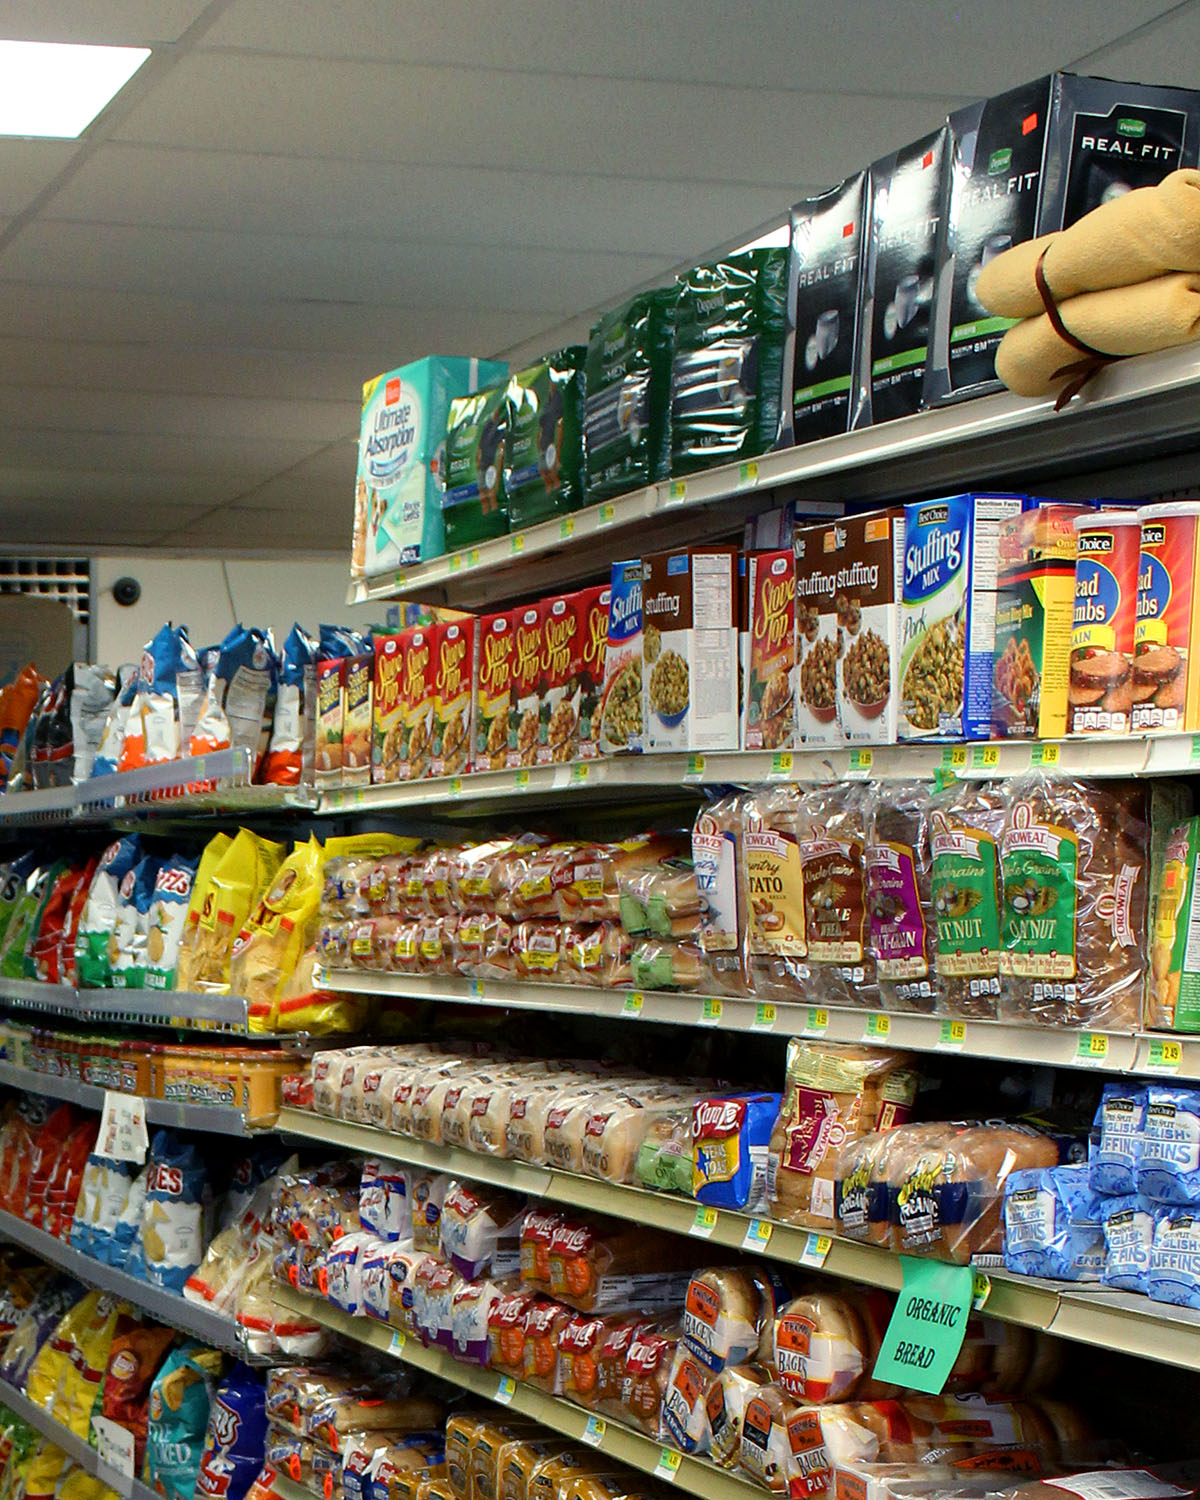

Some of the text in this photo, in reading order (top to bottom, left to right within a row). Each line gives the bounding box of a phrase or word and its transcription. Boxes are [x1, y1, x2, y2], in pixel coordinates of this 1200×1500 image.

[1081, 136, 1176, 160] REAL FIT
[1007, 171, 1039, 195] FIT
[799, 255, 858, 289] REAL FIT
[365, 426, 415, 458] Absorption
[905, 527, 961, 585] Stuffing
[797, 572, 836, 598] stuffing
[837, 563, 880, 590] stuffing
[921, 566, 941, 590] MIX
[1076, 572, 1099, 598] ead
[645, 592, 680, 617] stuffing
[755, 576, 795, 640] Stove
[1074, 599, 1105, 623] mbs
[767, 612, 790, 652] Top
[903, 608, 928, 646] Pork
[1073, 630, 1092, 645] AIN
[541, 615, 576, 671] Stove
[552, 648, 571, 681] Top
[748, 860, 781, 876] untry
[749, 876, 783, 893] TATO
[1116, 878, 1129, 934] OROWEAT
[1163, 1043, 1179, 1060] 2.49
[692, 1101, 722, 1137] Sara
[1106, 1122, 1138, 1133] GLISH
[1103, 1138, 1138, 1155] FFINS
[1150, 1127, 1186, 1140] GLISH
[906, 1296, 961, 1328] ORGANIC
[893, 1341, 936, 1369] BREAD
[795, 1448, 828, 1478] BAGELS
